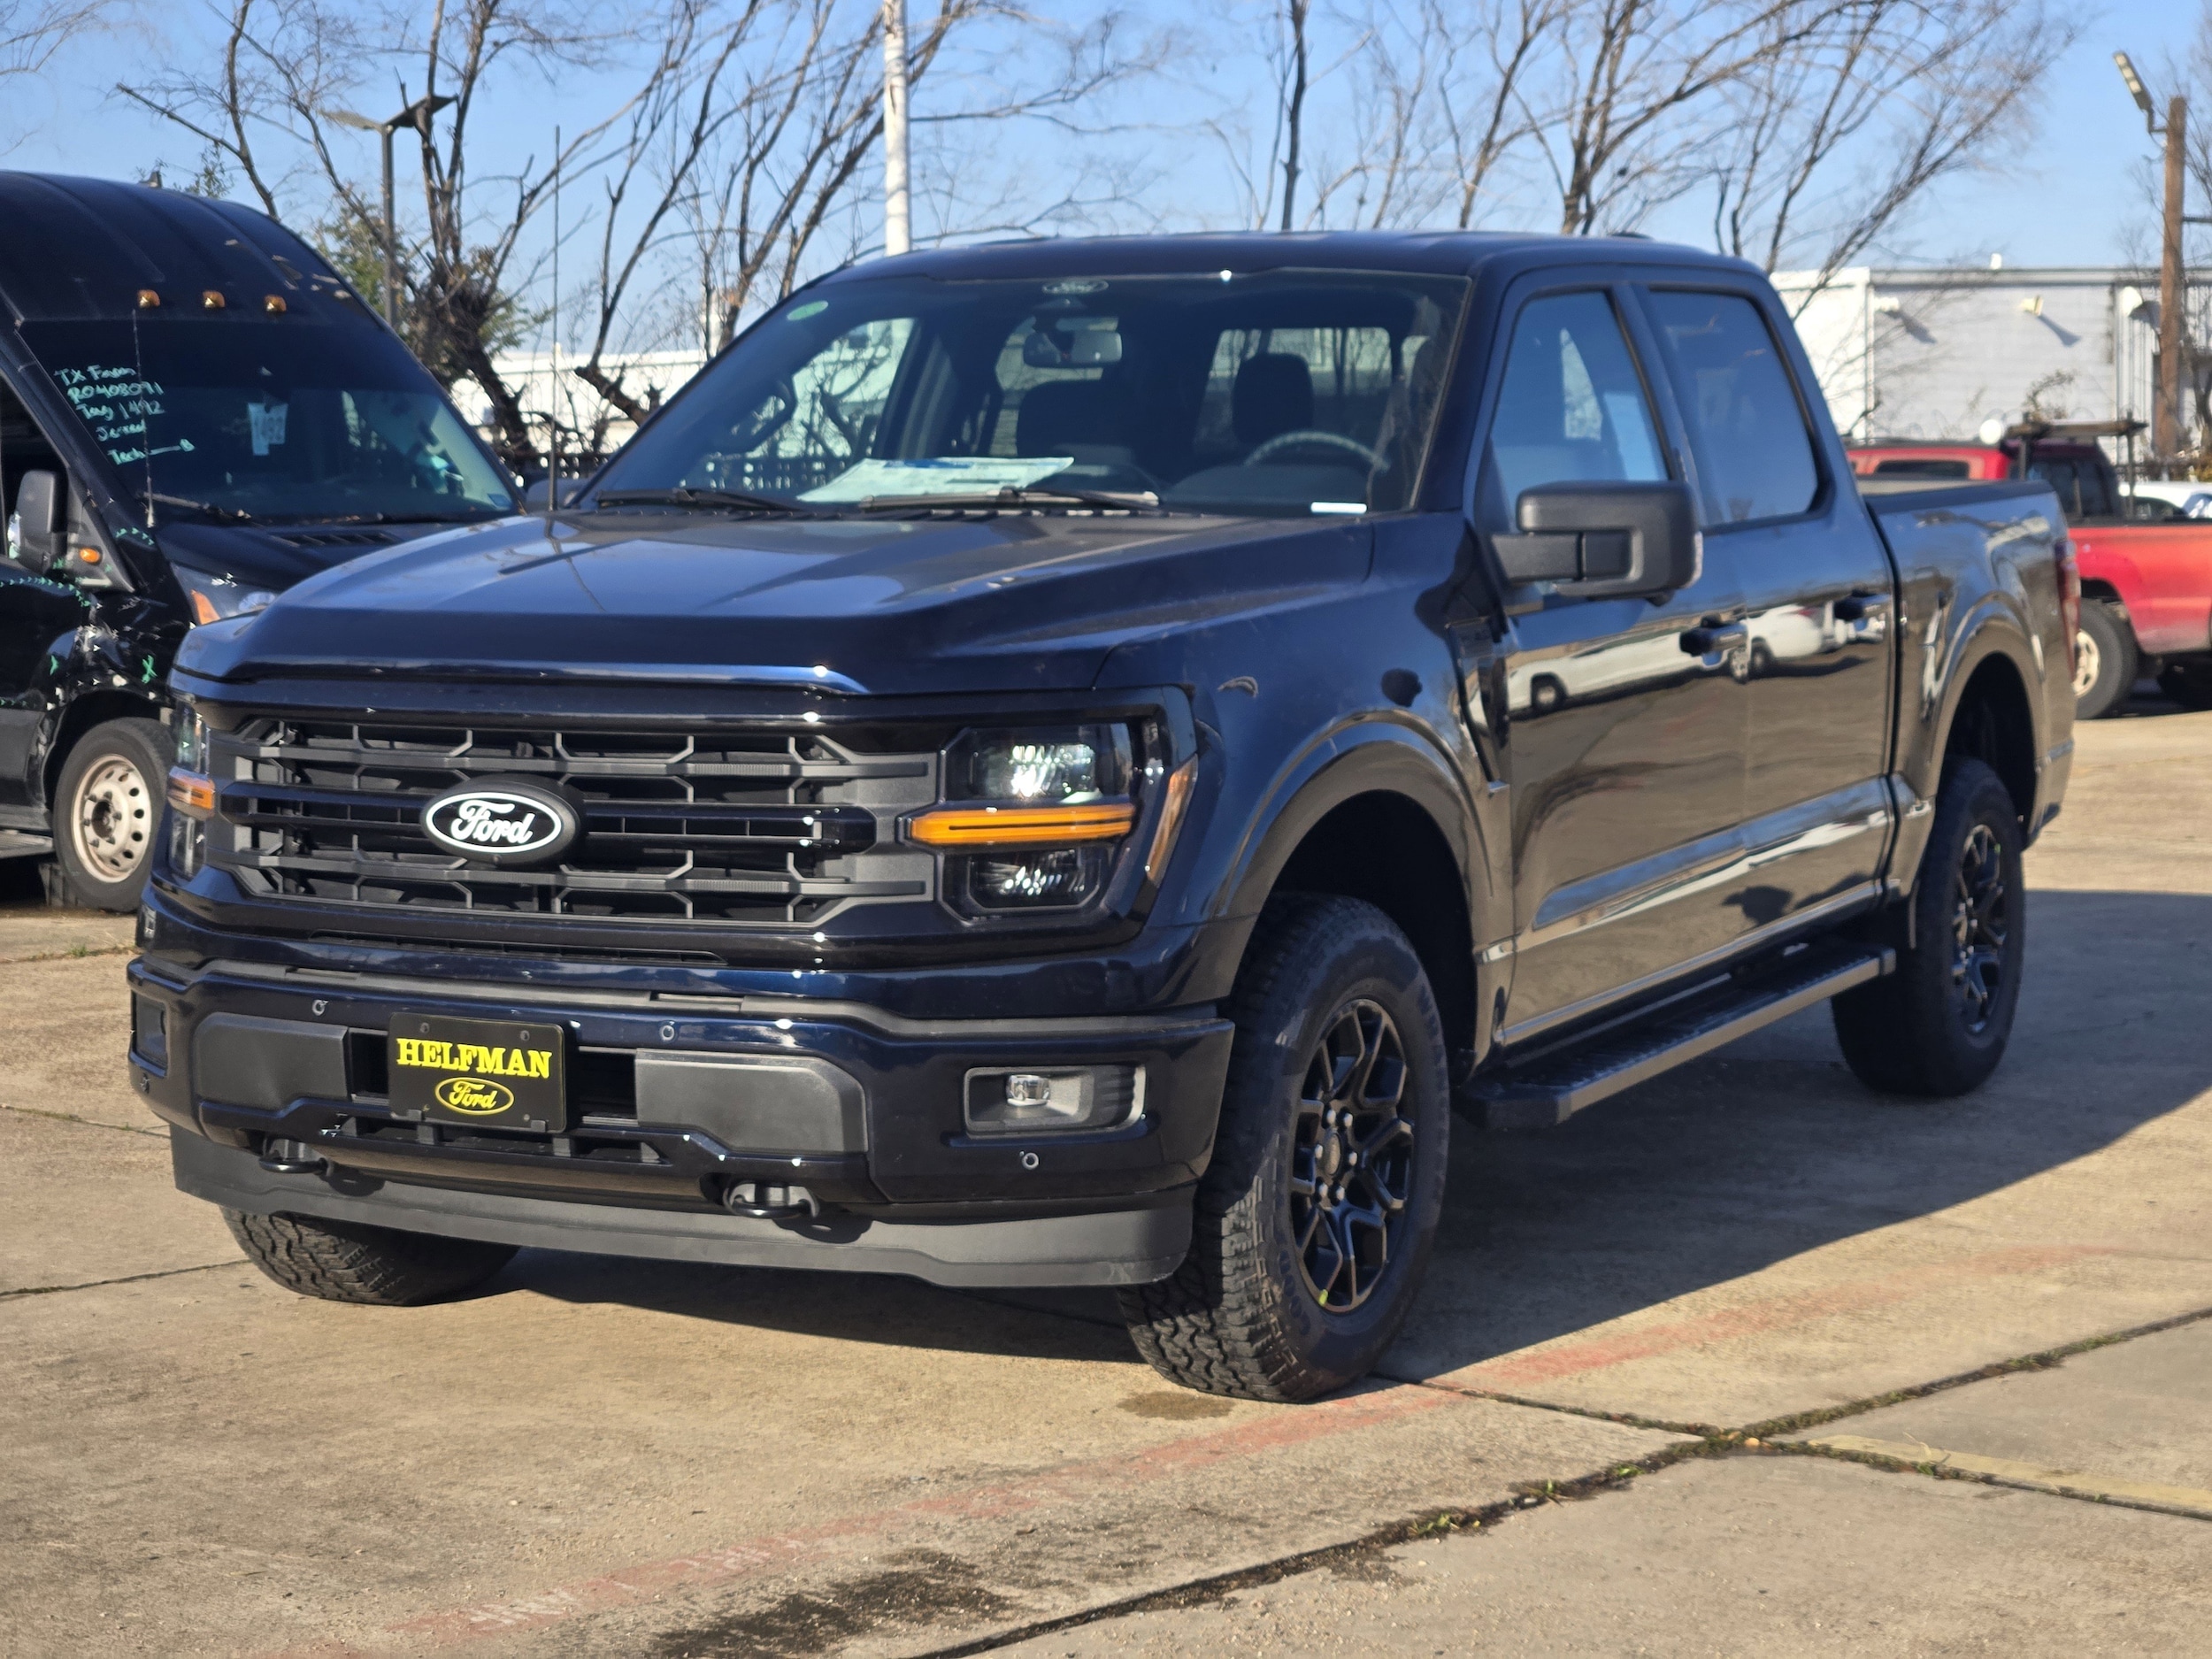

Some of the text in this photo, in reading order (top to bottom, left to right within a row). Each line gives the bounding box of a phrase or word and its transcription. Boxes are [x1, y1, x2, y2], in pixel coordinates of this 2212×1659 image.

[54, 368, 87, 386] TX
[451, 799, 536, 844] Ford
[396, 1037, 553, 1079] HELFMAN
[449, 1080, 498, 1110] Ford
